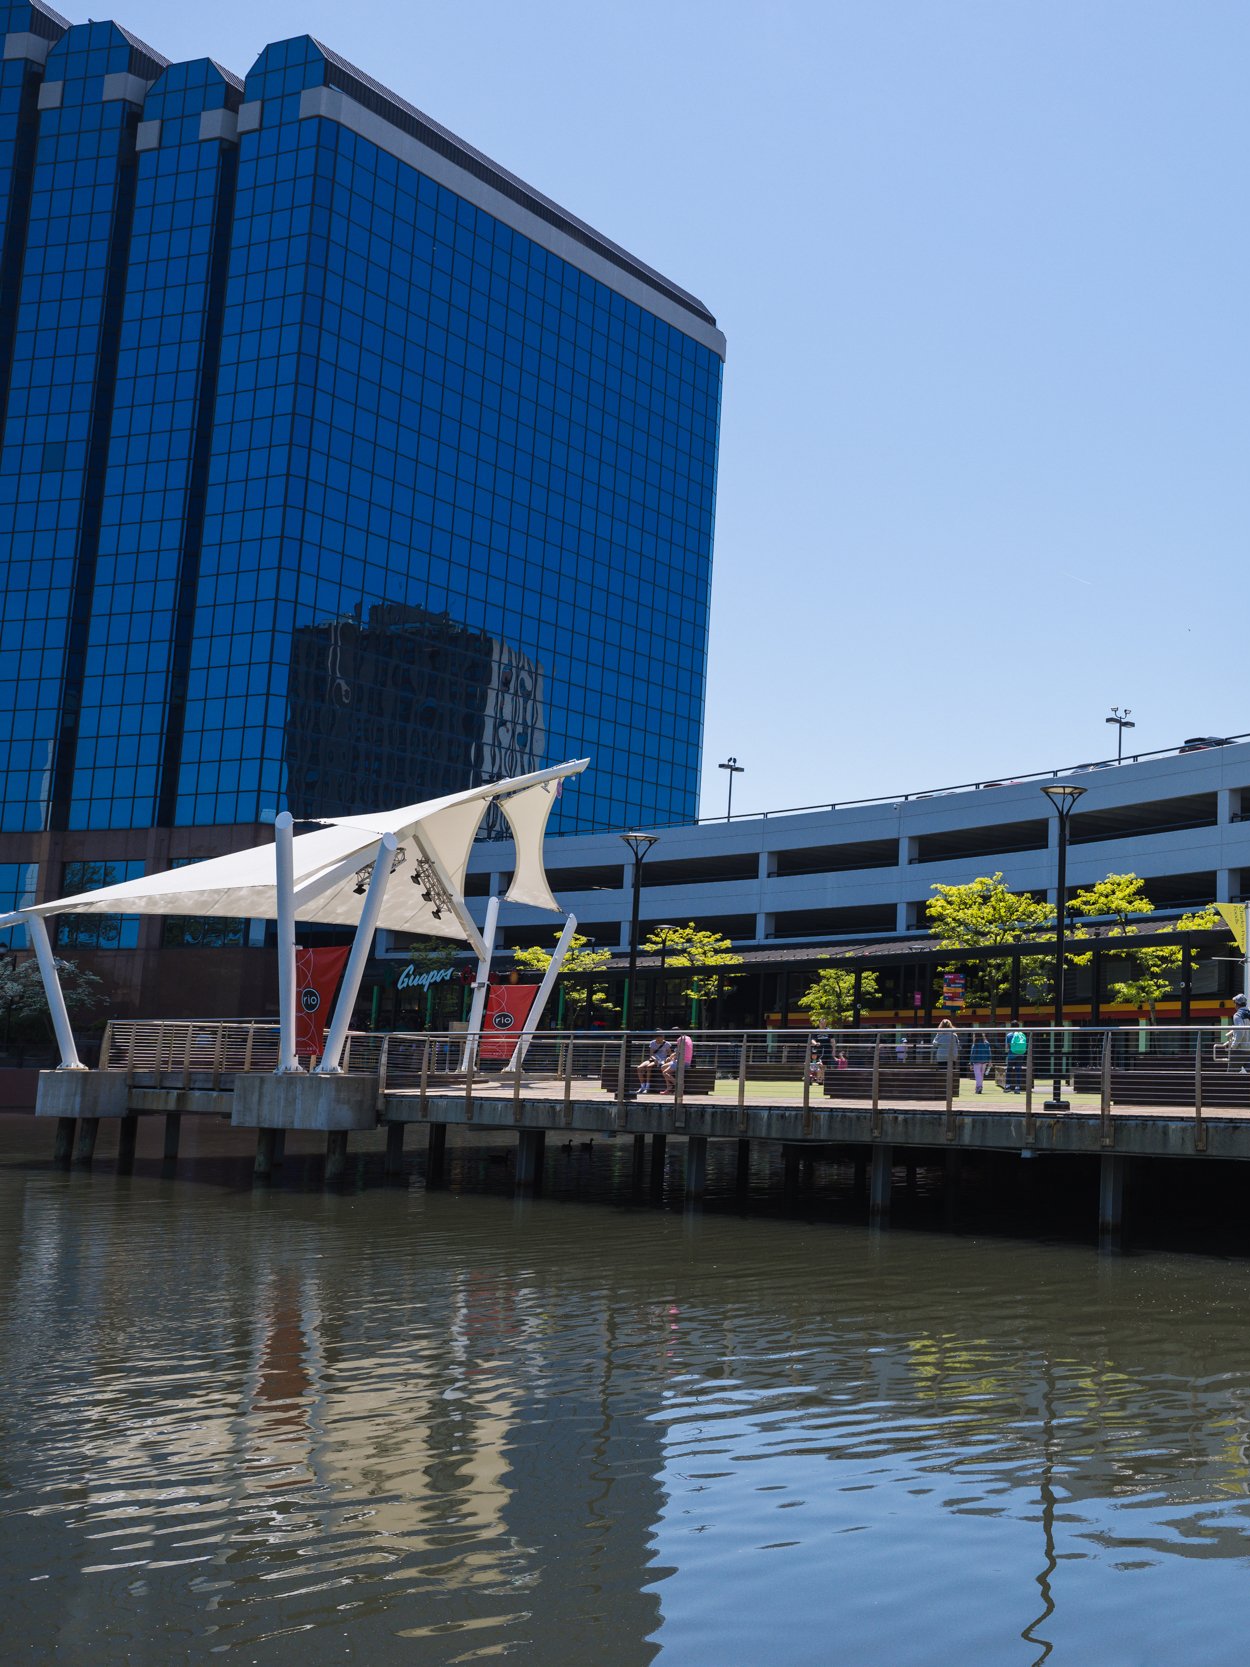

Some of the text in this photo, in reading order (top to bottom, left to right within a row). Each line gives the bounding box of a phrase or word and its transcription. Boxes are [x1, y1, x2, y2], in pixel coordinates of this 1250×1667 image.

[397, 964, 455, 993] Guapos
[303, 994, 317, 1005] rio
[495, 1016, 512, 1024] rio
